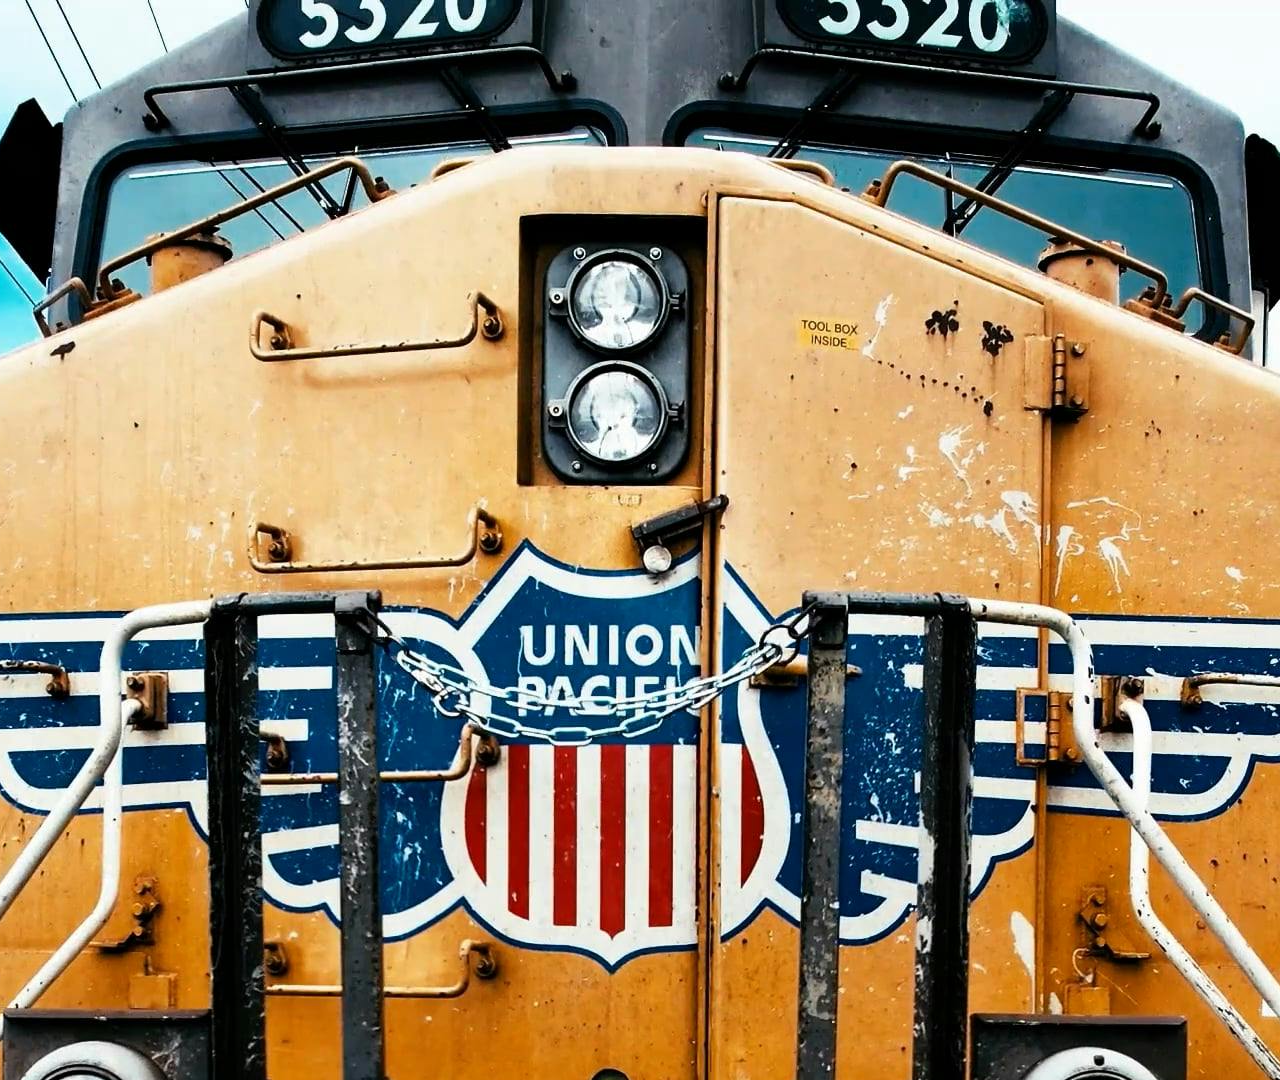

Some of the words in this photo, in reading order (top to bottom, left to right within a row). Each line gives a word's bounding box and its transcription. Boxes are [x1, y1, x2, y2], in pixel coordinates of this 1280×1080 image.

[801, 319, 831, 332] TOOL
[834, 323, 858, 336] BOX
[811, 334, 847, 348] INSIDE
[519, 624, 701, 666] UNION
